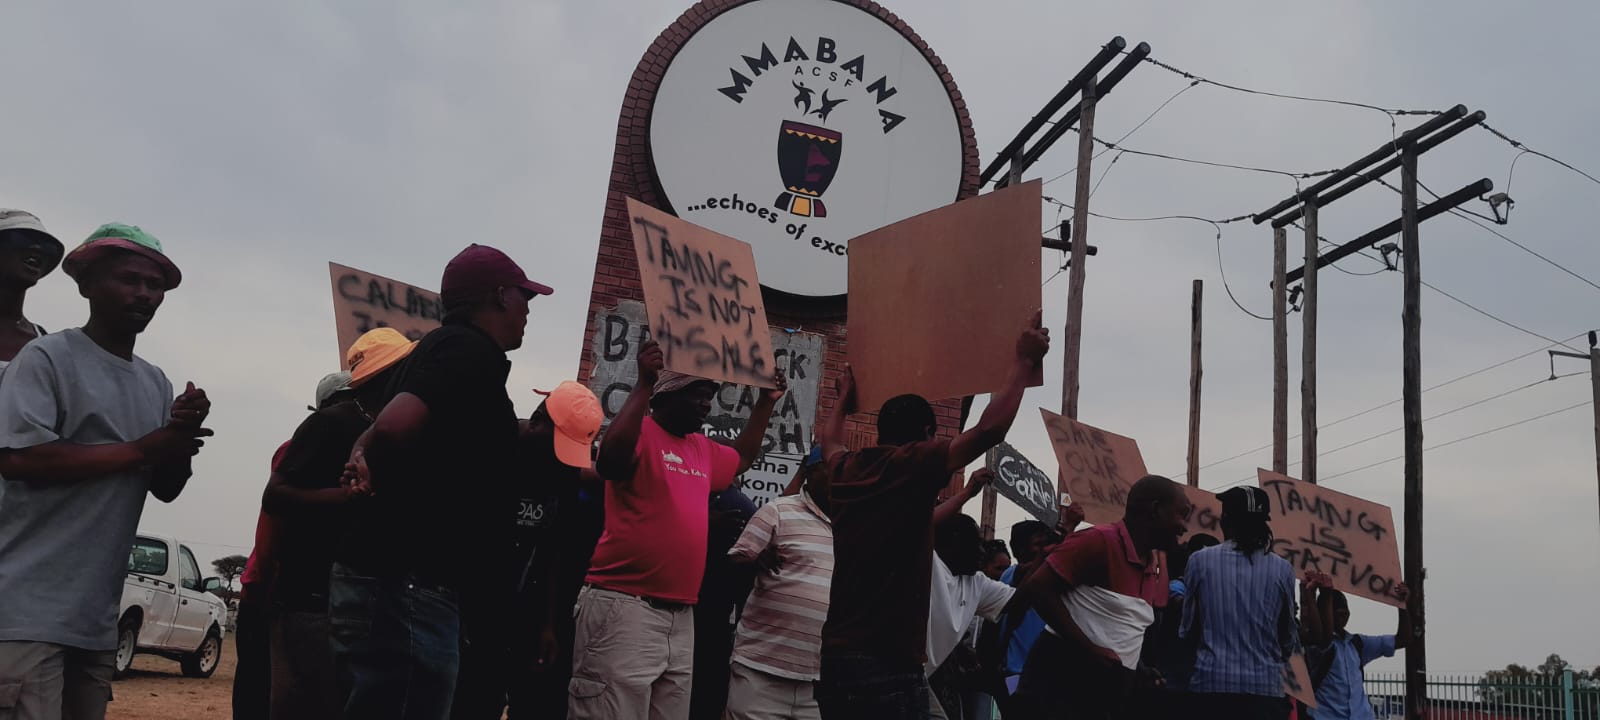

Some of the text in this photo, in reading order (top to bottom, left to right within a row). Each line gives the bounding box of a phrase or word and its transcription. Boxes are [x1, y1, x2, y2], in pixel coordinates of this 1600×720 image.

[717, 36, 907, 134] MMABANA
[634, 216, 748, 299] TAUNG
[785, 223, 807, 240] of
[811, 235, 848, 256] exc
[708, 292, 756, 337] NOT
[751, 460, 789, 475] ana
[1263, 479, 1387, 541] TAUNG
[1299, 523, 1347, 558] IS
